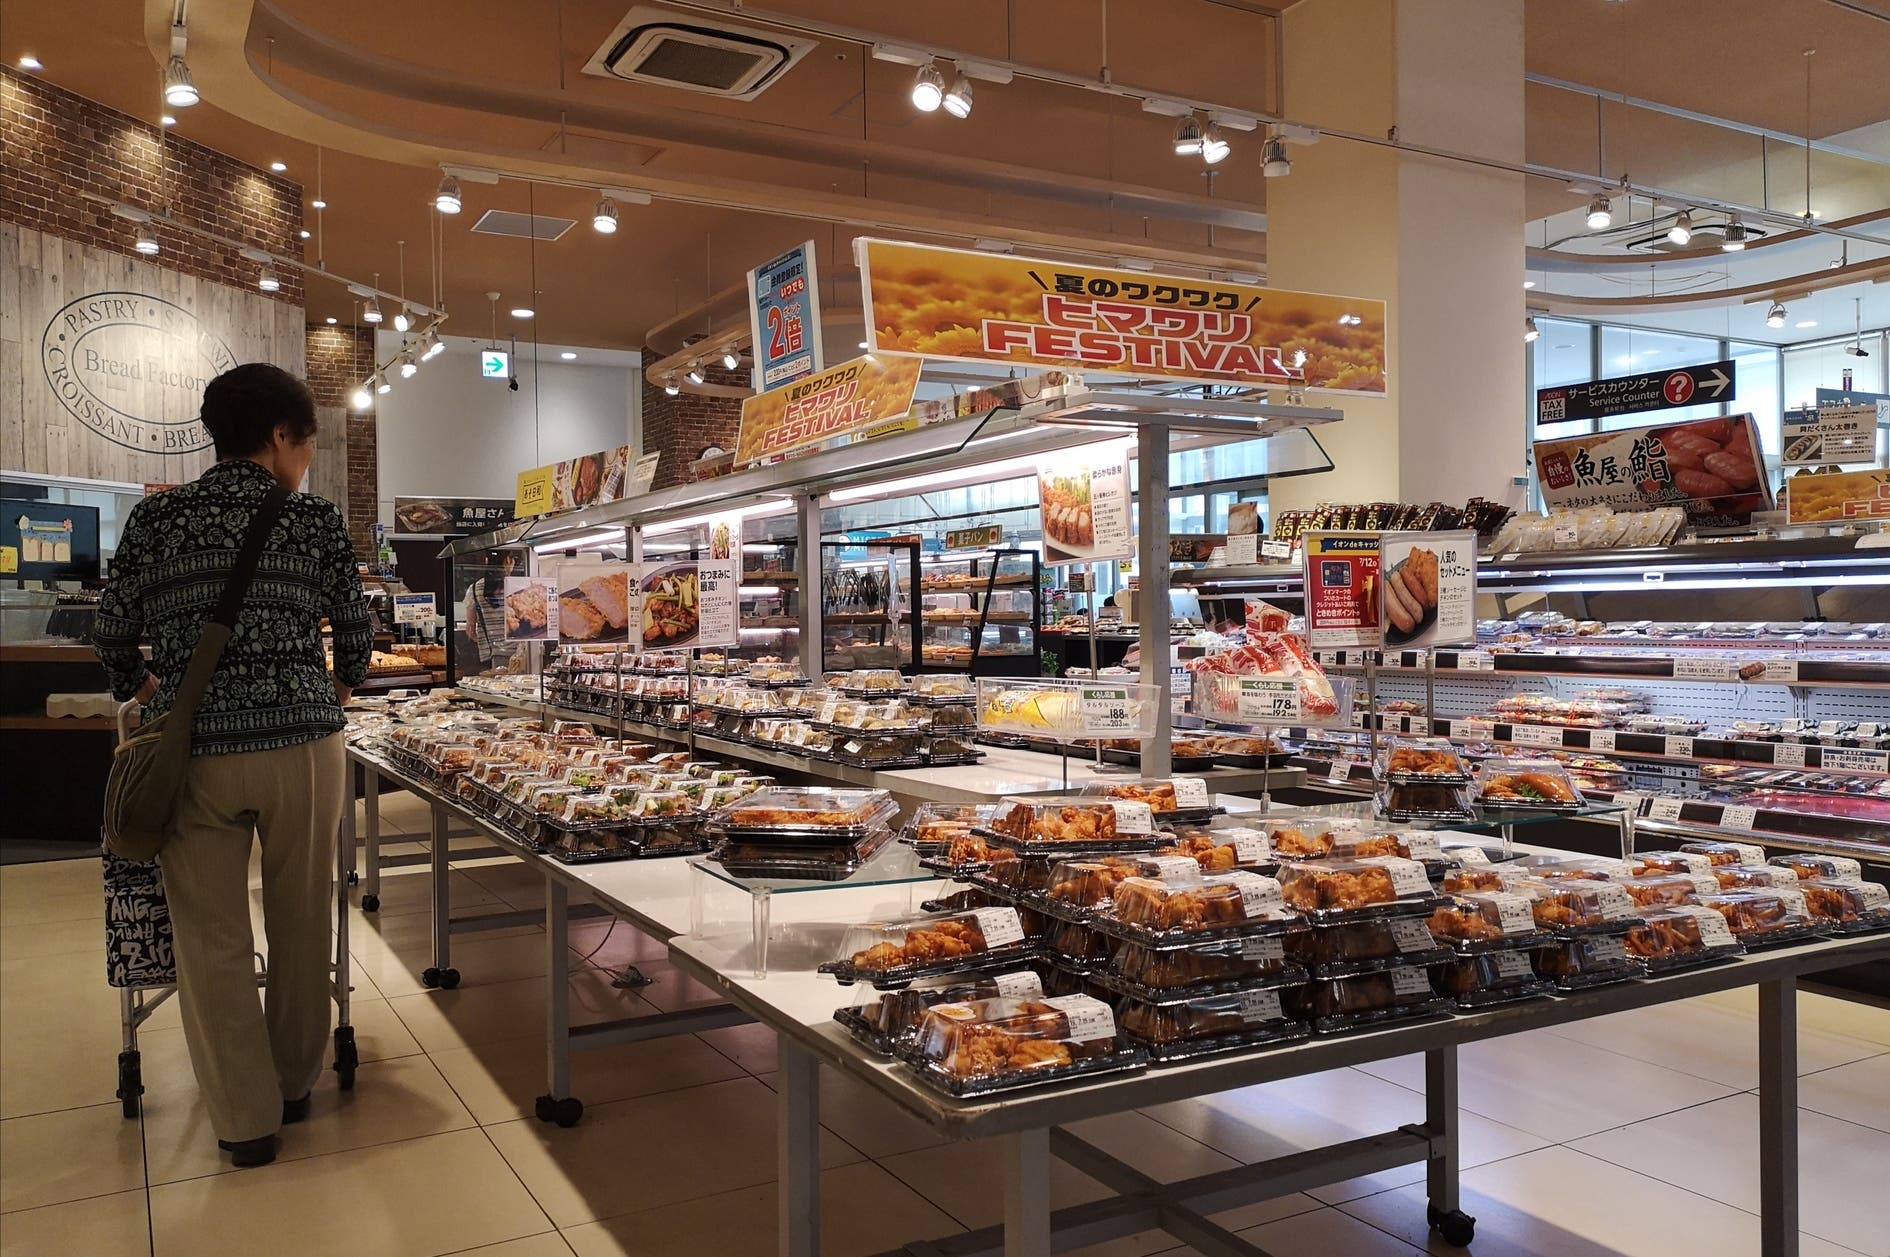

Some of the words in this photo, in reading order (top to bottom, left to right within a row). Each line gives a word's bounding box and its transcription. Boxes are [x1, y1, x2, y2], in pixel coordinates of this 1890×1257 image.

[780, 280, 804, 298] いつでも
[1055, 273, 1239, 310] 夏のワクワク
[65, 299, 139, 333] PASTRY
[1043, 294, 1252, 345] ヒマワリ
[768, 306, 802, 360] 2倍
[982, 319, 1304, 378] FESTIVAL
[85, 348, 142, 381] Bread
[149, 362, 212, 392] Factory
[48, 346, 144, 443] CROISSANT
[791, 366, 858, 400] 夏のワクワク
[1568, 377, 1660, 400] サービスカウンター
[784, 380, 859, 424] ヒマワリ
[1543, 400, 1562, 410] TAX
[1589, 395, 1621, 408] Service
[1622, 390, 1660, 403] Counter
[761, 398, 872, 451] FESTIVAL
[1542, 410, 1564, 420] FREE
[1573, 438, 1671, 488] 魚屋の鮨
[958, 530, 984, 545] 菓子パン
[1440, 550, 1457, 564] 人気の
[700, 570, 731, 580] おつまみに
[1440, 565, 1470, 578] セットメニュー
[700, 581, 718, 592] 最高!
[1109, 708, 1129, 719] 188円
[1272, 699, 1297, 710] 178円
